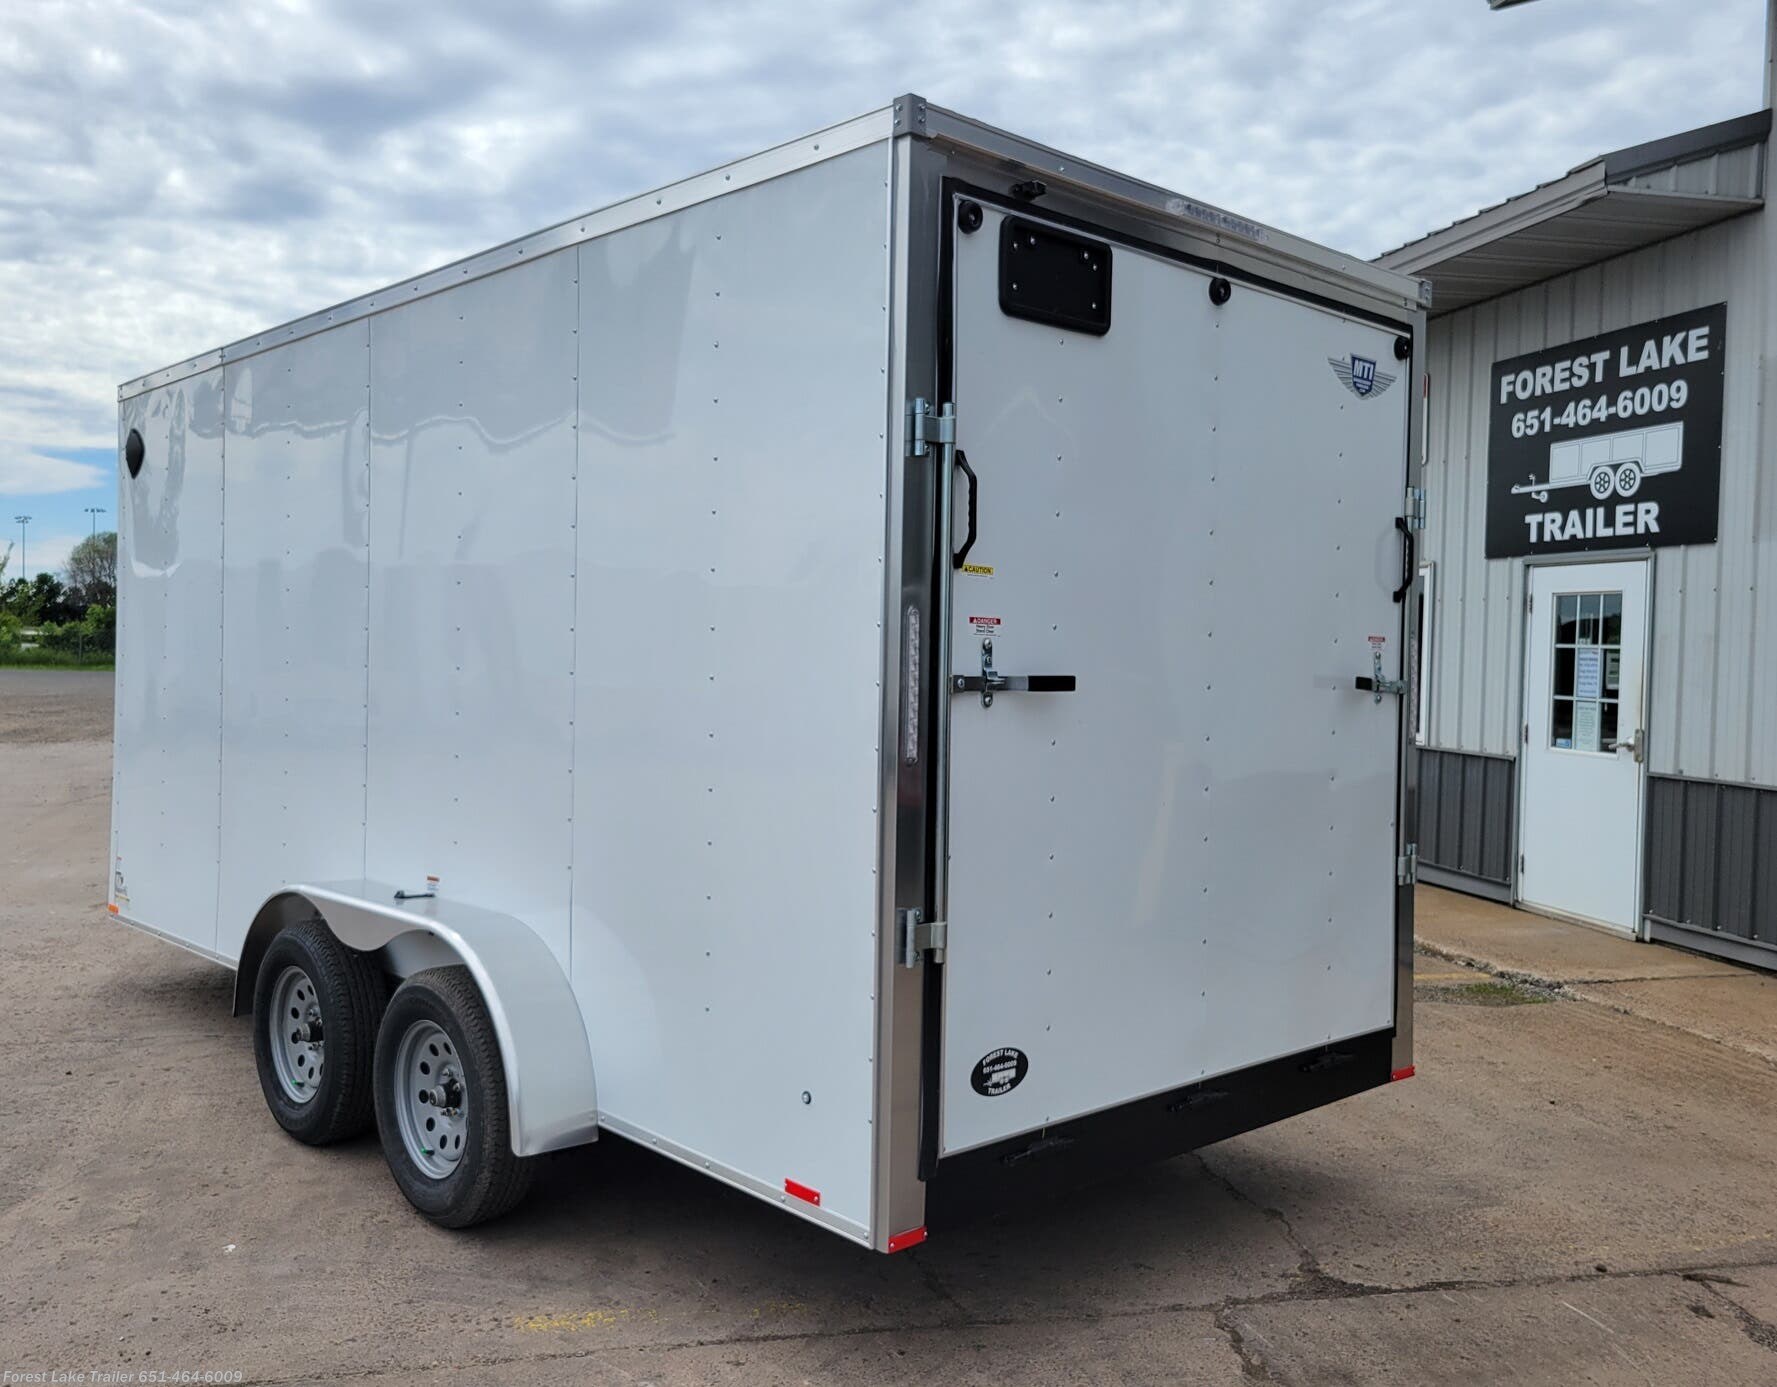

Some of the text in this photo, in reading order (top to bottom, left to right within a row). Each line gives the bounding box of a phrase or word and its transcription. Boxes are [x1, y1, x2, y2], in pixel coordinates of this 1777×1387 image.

[1500, 326, 1709, 404] FOREST LAKE
[1511, 379, 1688, 438] 651-464-6009
[1525, 501, 1660, 543] TRAILER
[968, 566, 992, 574] CAUTION
[983, 1049, 1019, 1066] FOREST LAKE
[988, 1083, 1011, 1095] TRAILER
